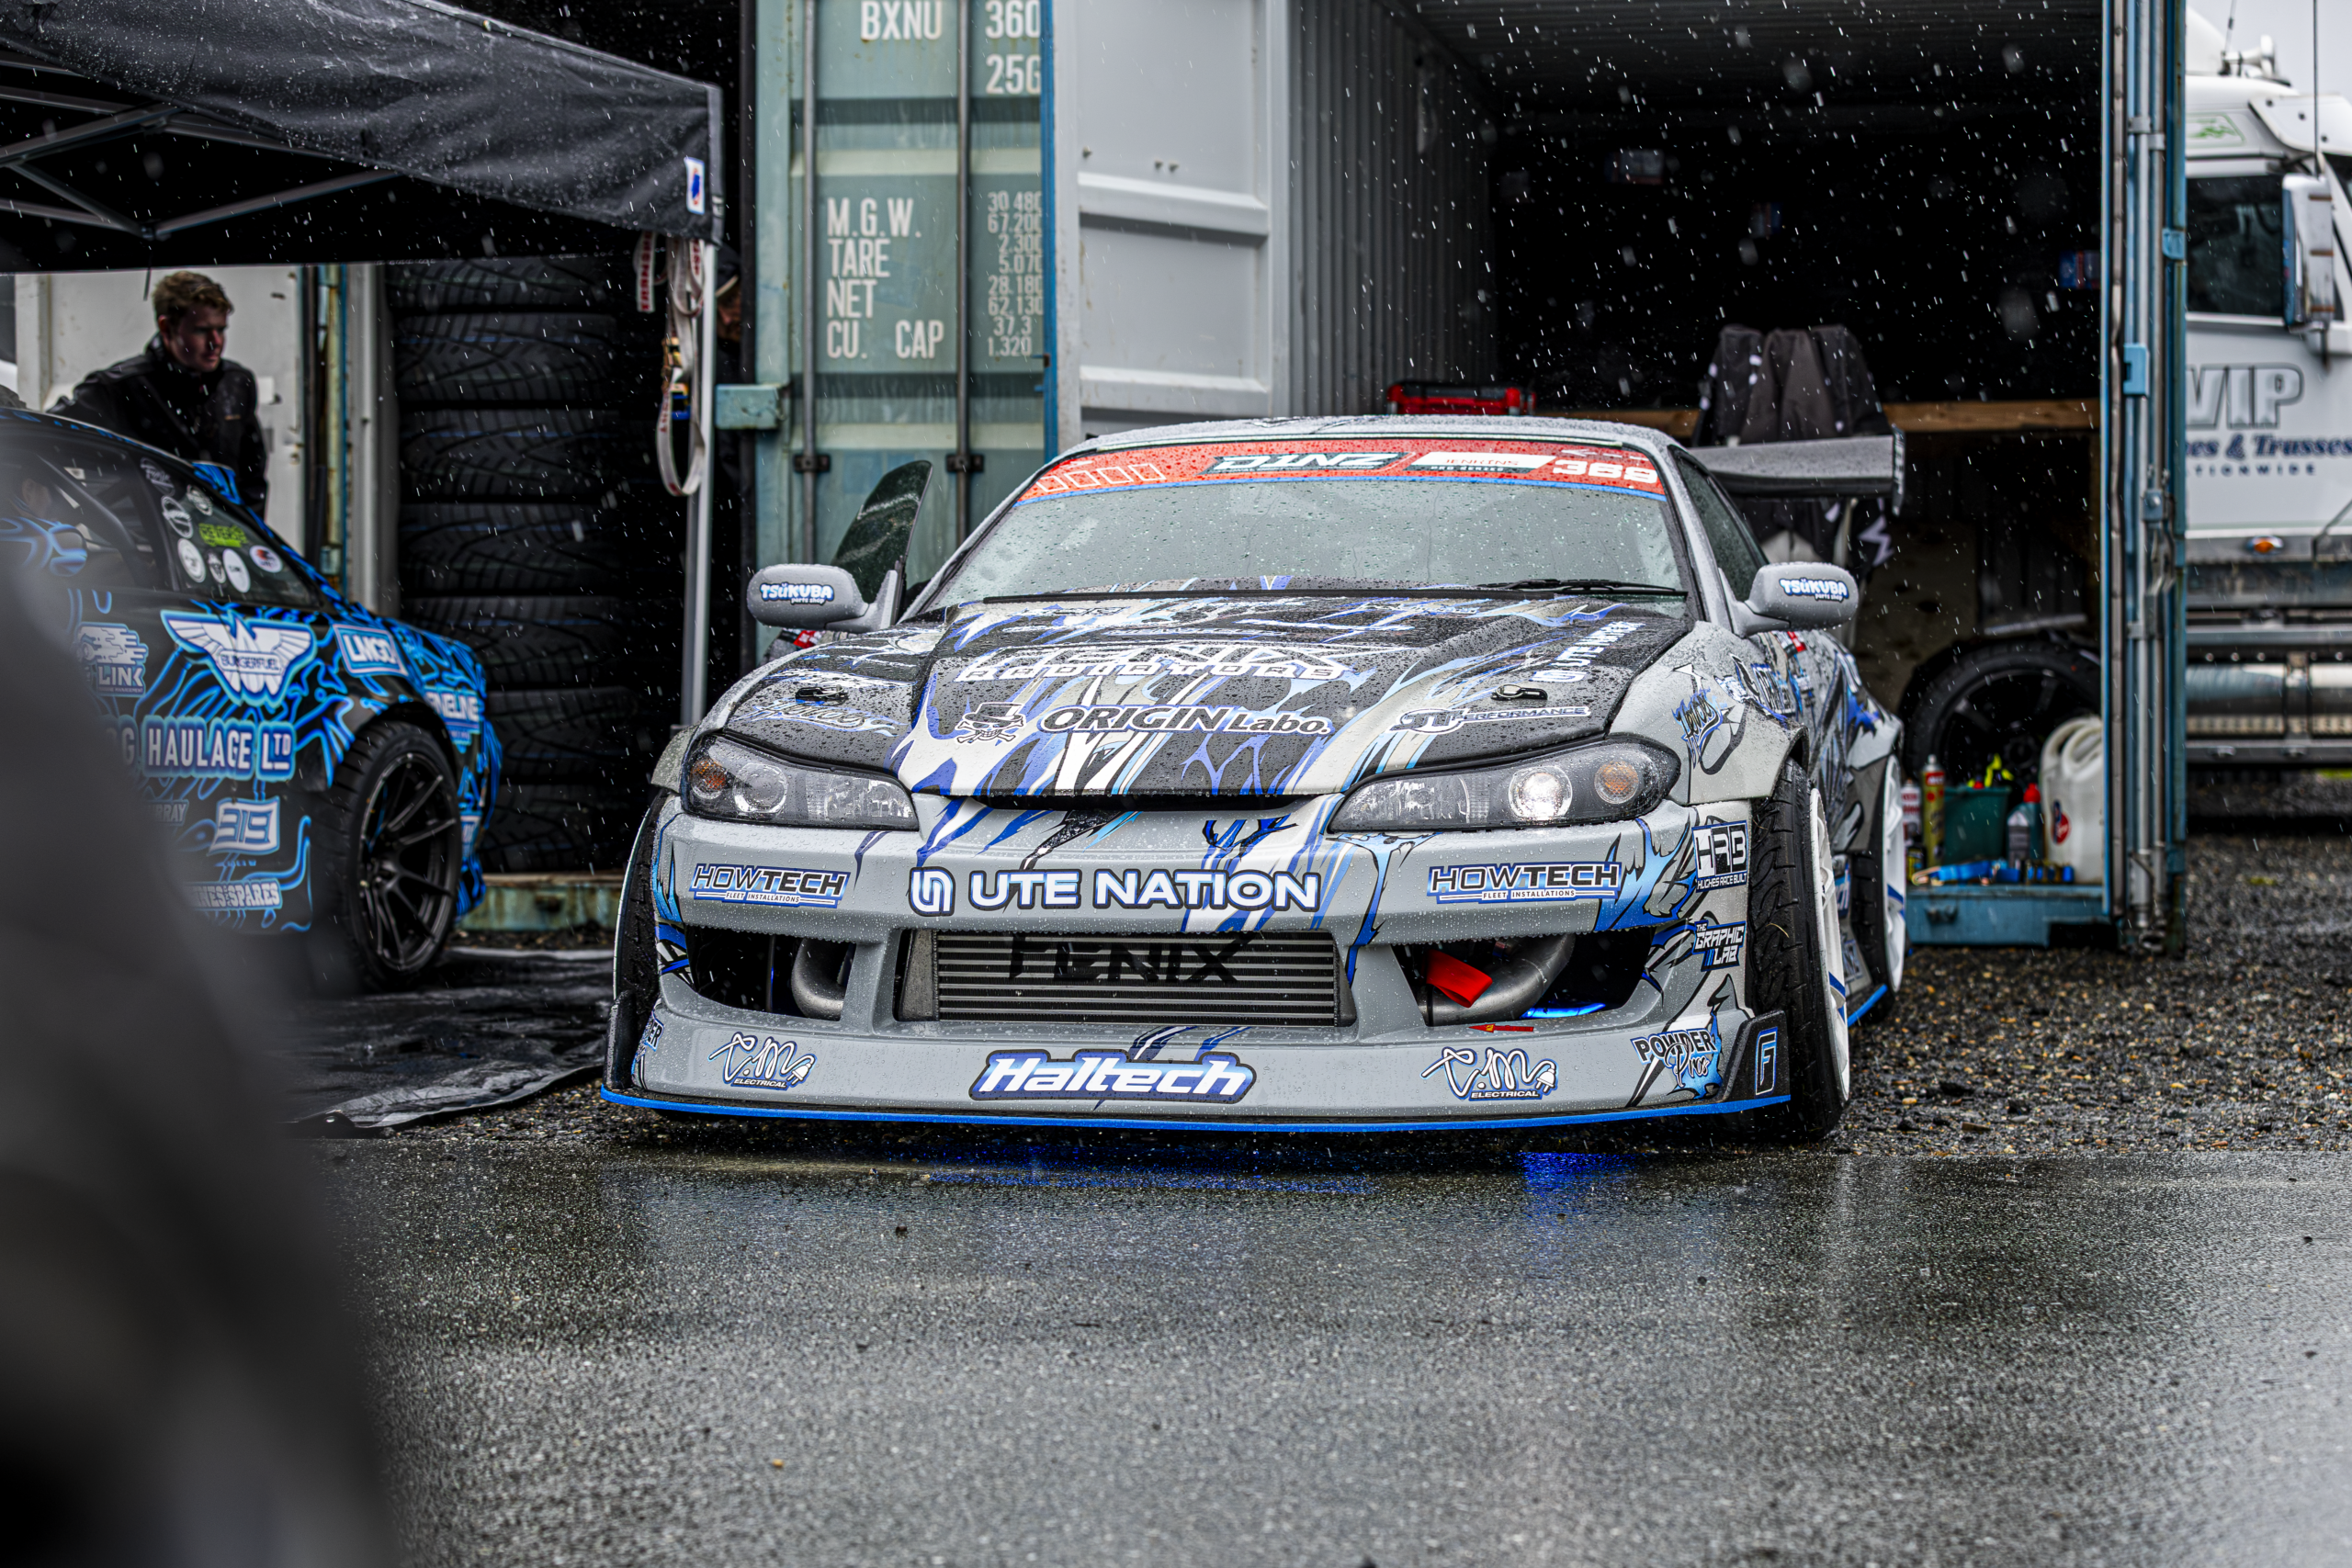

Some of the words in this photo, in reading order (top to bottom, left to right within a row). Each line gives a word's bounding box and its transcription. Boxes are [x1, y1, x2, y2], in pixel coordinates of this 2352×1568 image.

[861, 0, 943, 39] BXNU
[829, 239, 890, 277] TARE
[828, 279, 878, 319] NET
[895, 320, 944, 359] CAP
[2187, 462, 2316, 478] TIONWIDE
[98, 665, 143, 687] LINK
[1042, 705, 1231, 732] ORIGIN
[1453, 707, 1587, 721] PERFORMANCE
[148, 728, 253, 770] HAULAGE
[693, 866, 848, 897] HOWTECH
[973, 872, 1080, 908] UTE
[1096, 872, 1317, 908] NATION
[1430, 863, 1620, 894] HOWTECH
[1697, 876, 1720, 890] HUGHES
[747, 893, 800, 903] INSTALLATIONS
[1511, 889, 1576, 898] INSTALLATIONS
[1694, 925, 1745, 950] GRAPHIC
[1696, 922, 1707, 931] THE
[1010, 931, 1259, 984] FENIX
[1713, 944, 1739, 965] LAB
[1632, 1028, 1718, 1064] POWDER
[733, 1077, 788, 1089] ELECTRICAL
[978, 1056, 1247, 1096] Haltech
[1471, 1090, 1539, 1099] ELECTRICAL
